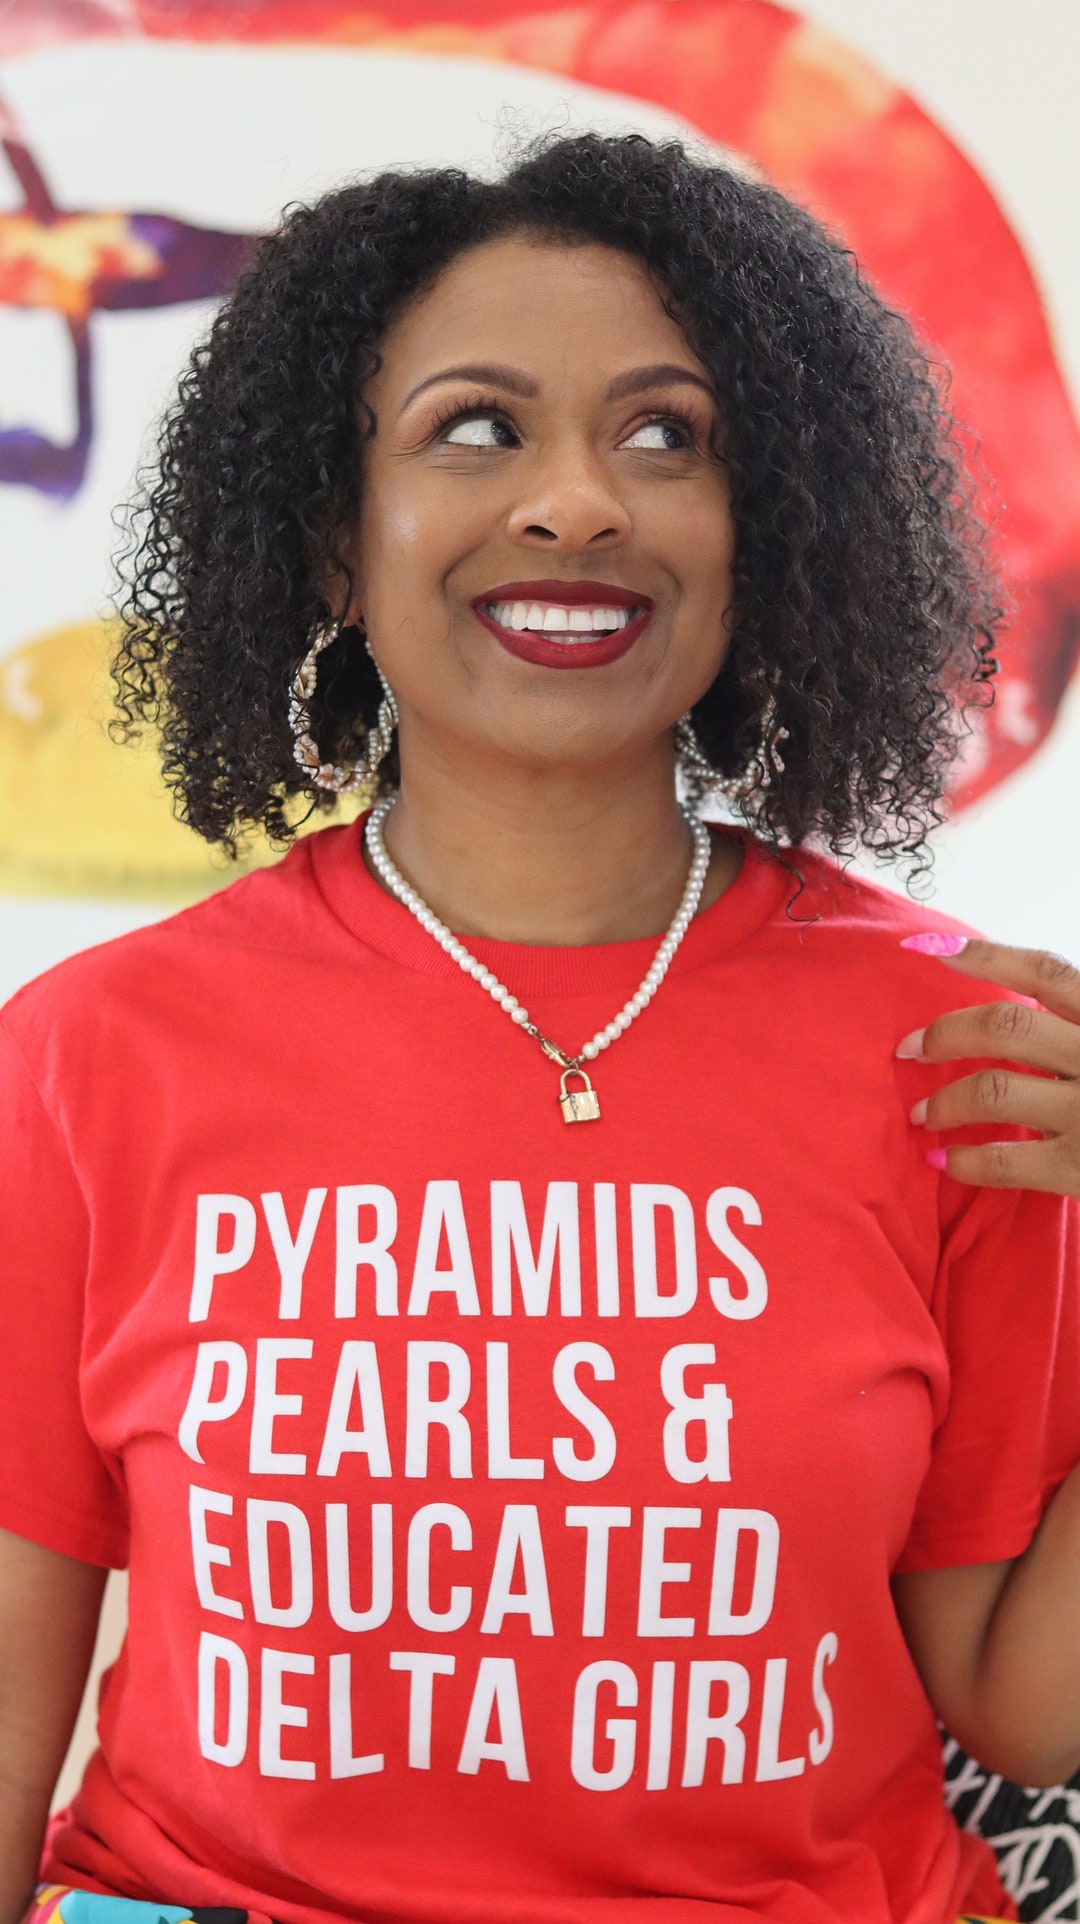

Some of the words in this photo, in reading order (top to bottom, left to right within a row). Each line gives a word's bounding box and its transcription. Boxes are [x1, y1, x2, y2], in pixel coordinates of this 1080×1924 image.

[189, 1180, 768, 1322] PYRAMIDS
[178, 1338, 616, 1481] PEARLS
[661, 1343, 734, 1484] &
[189, 1484, 780, 1637] EDUCATED
[197, 1632, 530, 1782] DELTA
[571, 1631, 838, 1792] GIRLS
